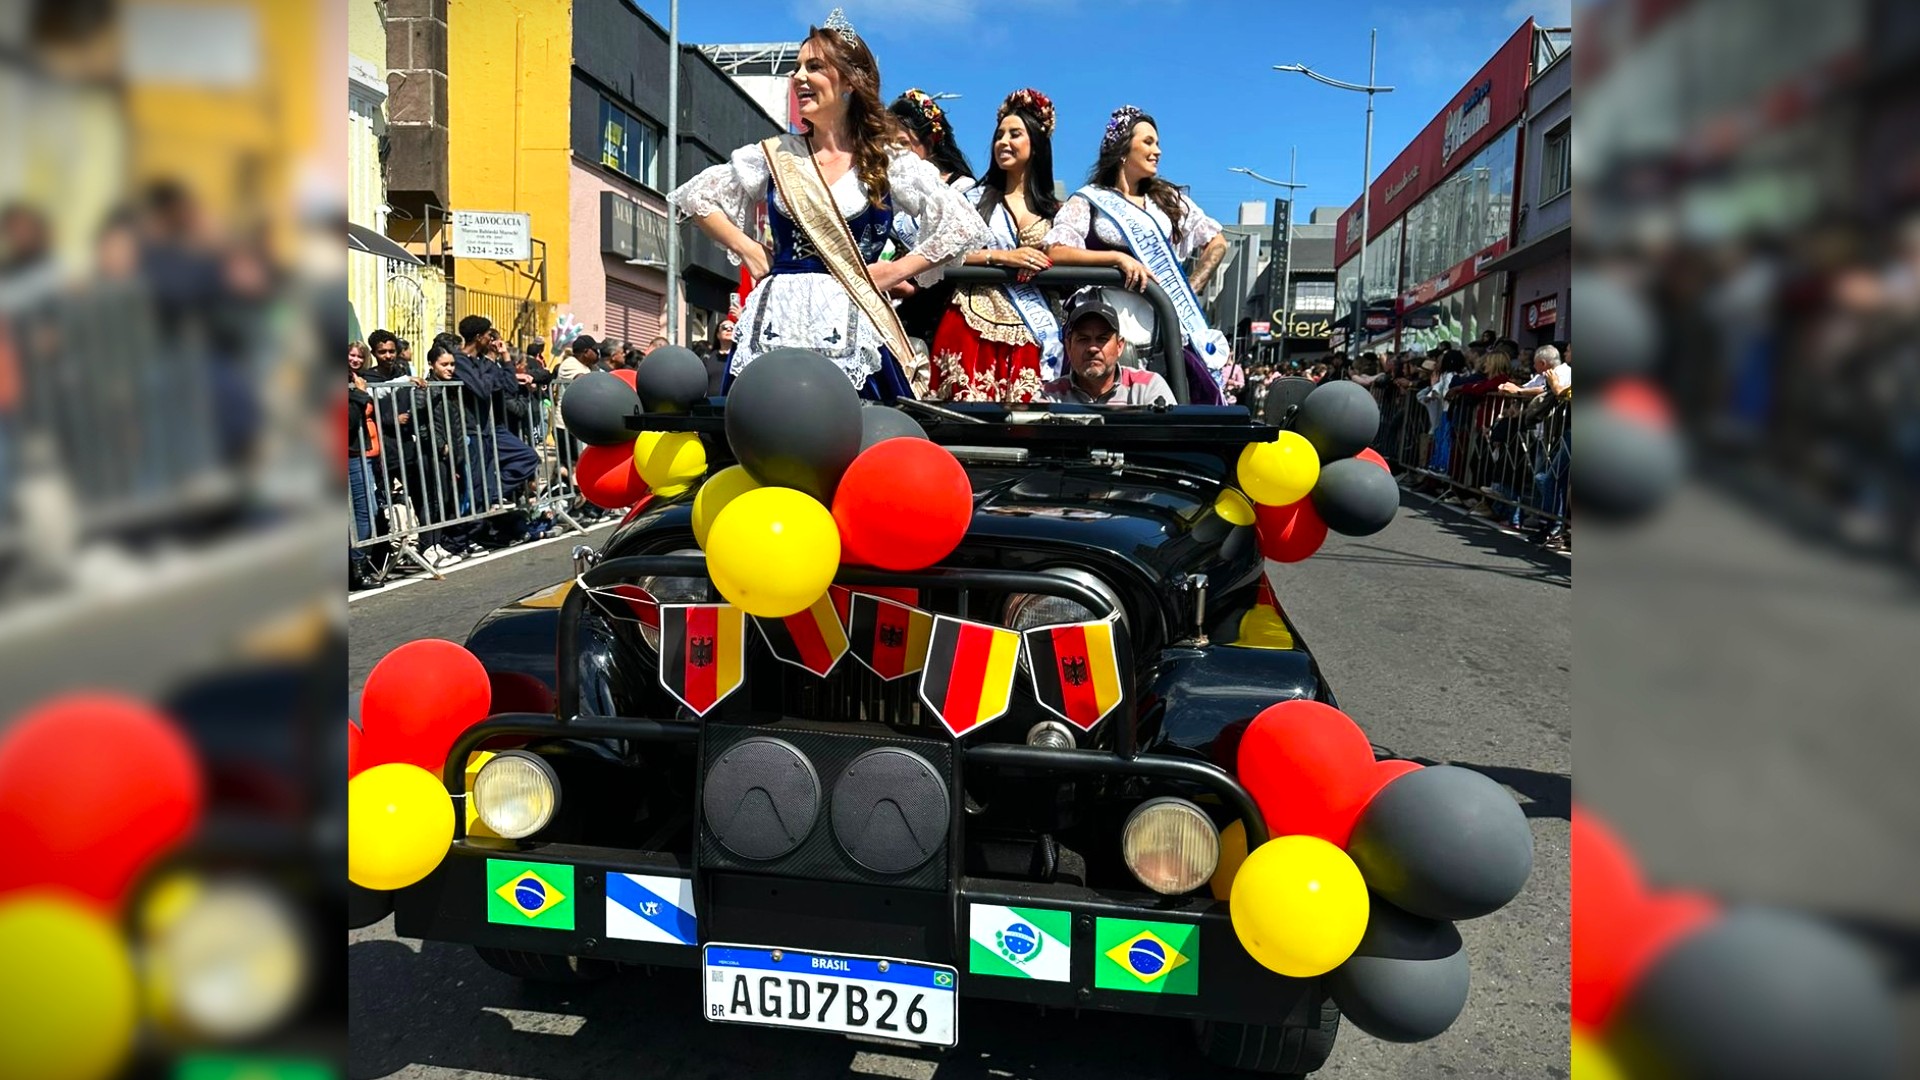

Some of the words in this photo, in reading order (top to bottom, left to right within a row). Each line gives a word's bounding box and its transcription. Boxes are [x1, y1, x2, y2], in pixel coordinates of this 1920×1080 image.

[474, 216, 521, 226] ADVOCACIA
[466, 246, 486, 254] 3224
[495, 247, 514, 256] 2255
[811, 957, 850, 971] BRASIL
[711, 1003, 725, 1017] BR
[730, 974, 928, 1034] AGD7B26
